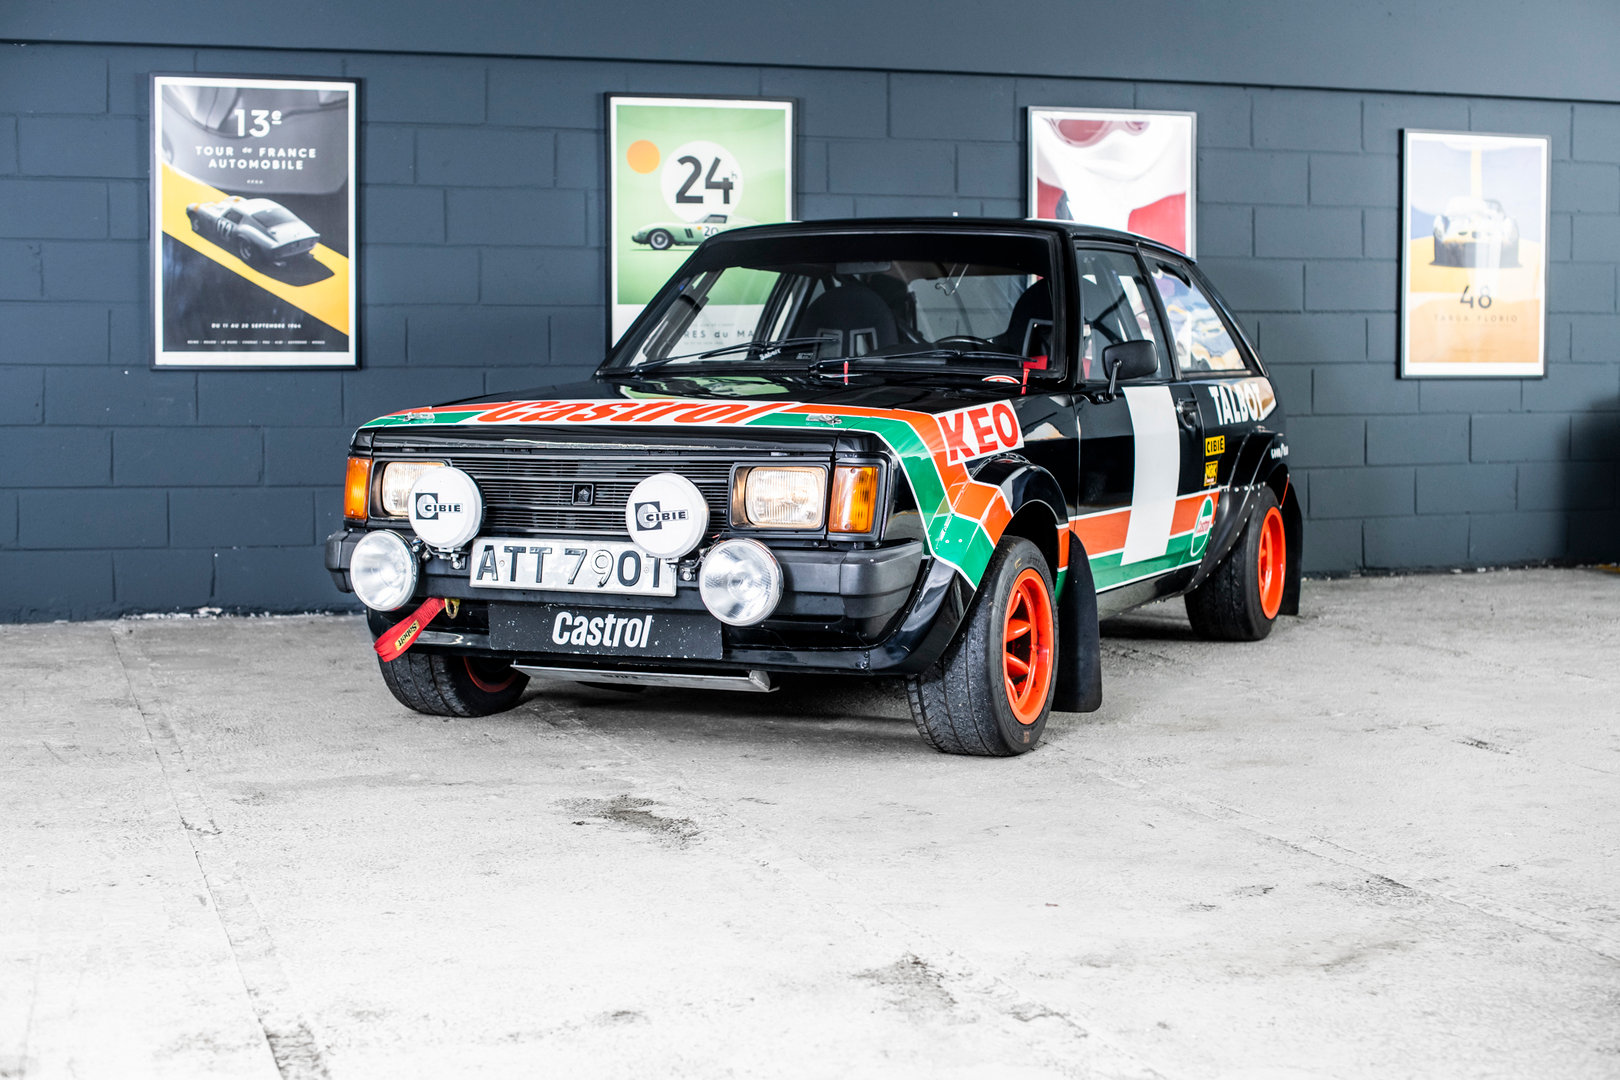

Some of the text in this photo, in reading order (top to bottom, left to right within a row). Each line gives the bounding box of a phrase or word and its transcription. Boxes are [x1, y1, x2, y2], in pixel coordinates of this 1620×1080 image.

[195, 146, 234, 156] TOUR
[259, 147, 316, 158] FRANCE
[208, 159, 304, 170] AUTOMOBILE
[1460, 285, 1492, 309] 48
[684, 330, 706, 338] RES
[737, 330, 754, 338] MA
[477, 400, 792, 424] Castrol
[1208, 382, 1265, 425] TALBOT
[937, 403, 1019, 462] KEO
[424, 504, 461, 512] CIBIE
[645, 511, 686, 521] CIBIE
[476, 544, 553, 583] ATT
[552, 611, 653, 648] Castrol
